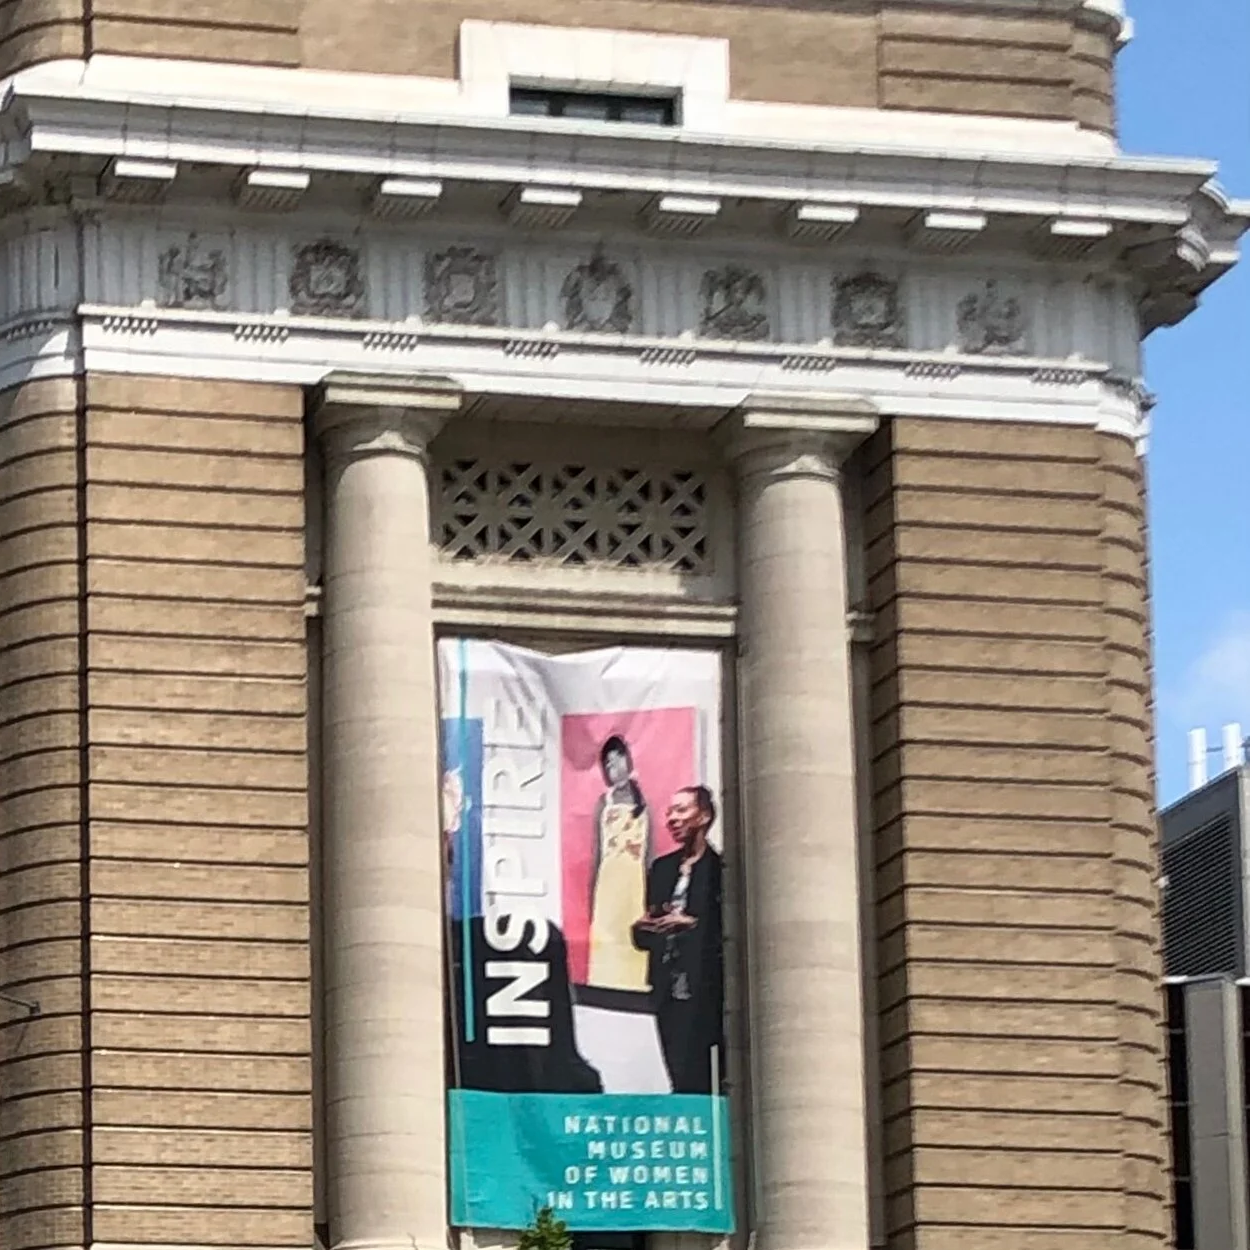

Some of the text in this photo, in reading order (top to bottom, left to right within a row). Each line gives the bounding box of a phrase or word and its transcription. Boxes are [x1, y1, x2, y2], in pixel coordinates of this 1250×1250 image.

[483, 674, 551, 1047] INSPIRE
[564, 1115, 708, 1135] NATIONAL
[588, 1140, 708, 1160] MUSEUM
[564, 1165, 708, 1184] OF WOMEN
[547, 1191, 709, 1210] IN THE ARTS
